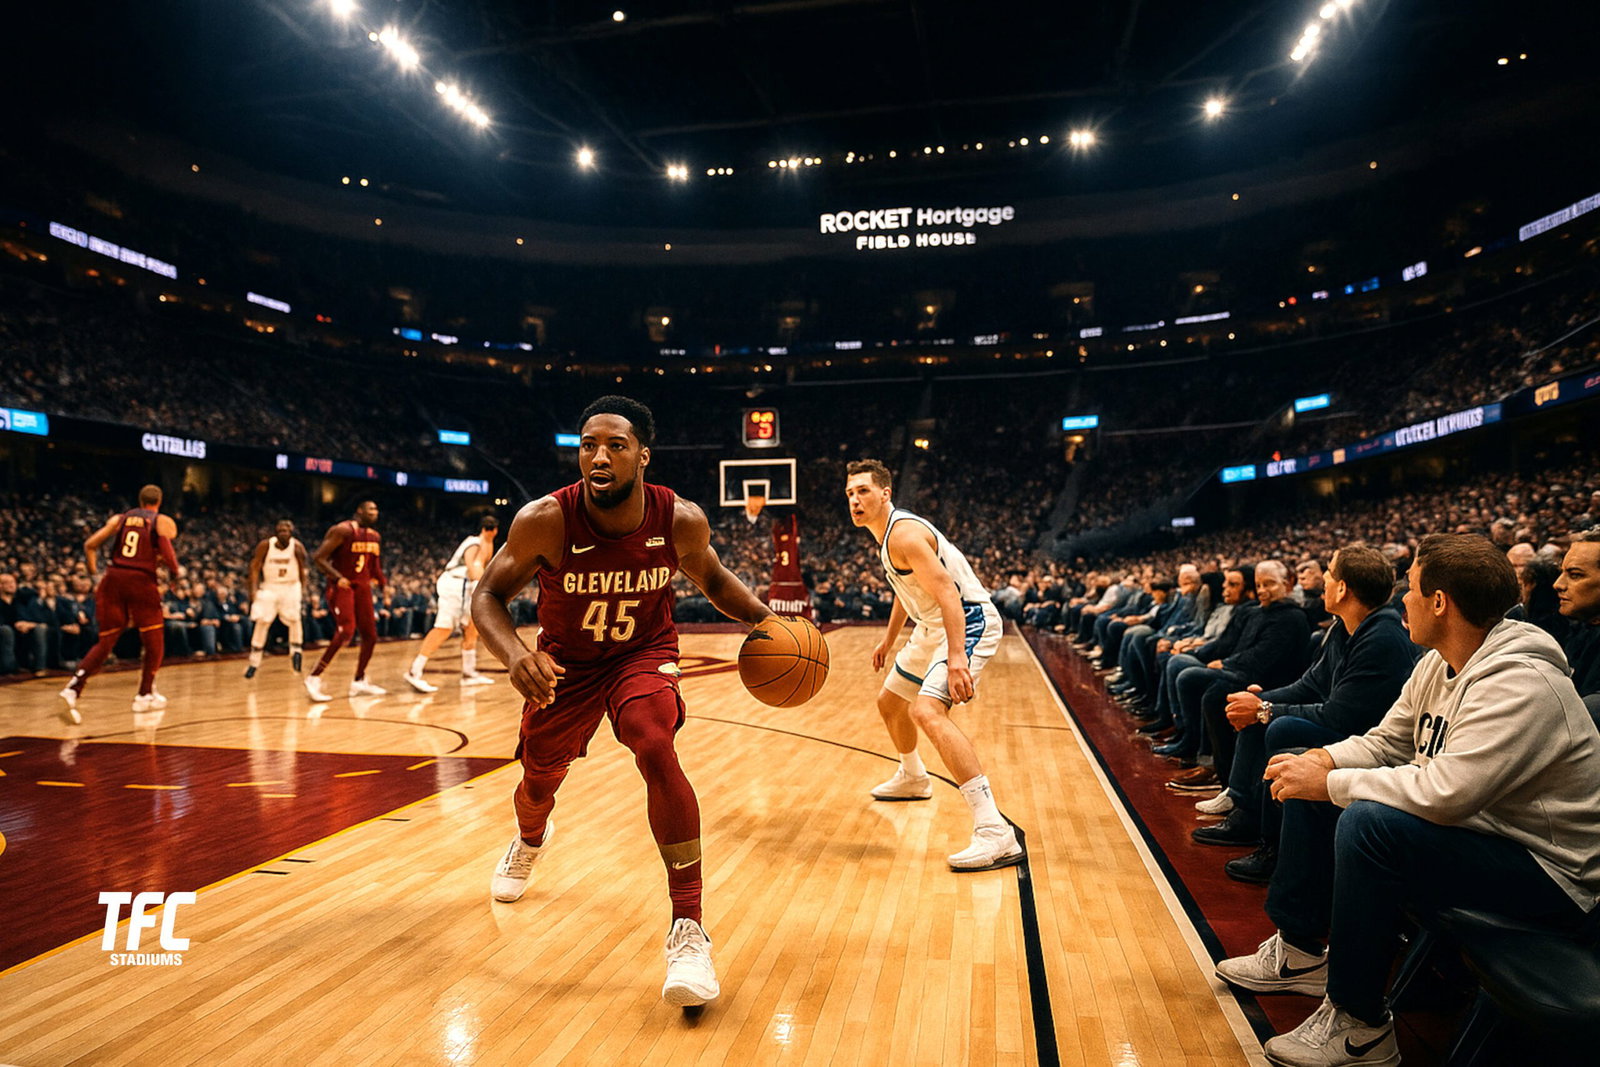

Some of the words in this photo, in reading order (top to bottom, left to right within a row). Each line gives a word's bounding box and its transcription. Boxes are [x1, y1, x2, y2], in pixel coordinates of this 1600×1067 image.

[820, 207, 913, 234] ROCKET
[122, 531, 140, 558] 9
[780, 551, 789, 566] 3
[582, 600, 640, 642] 45
